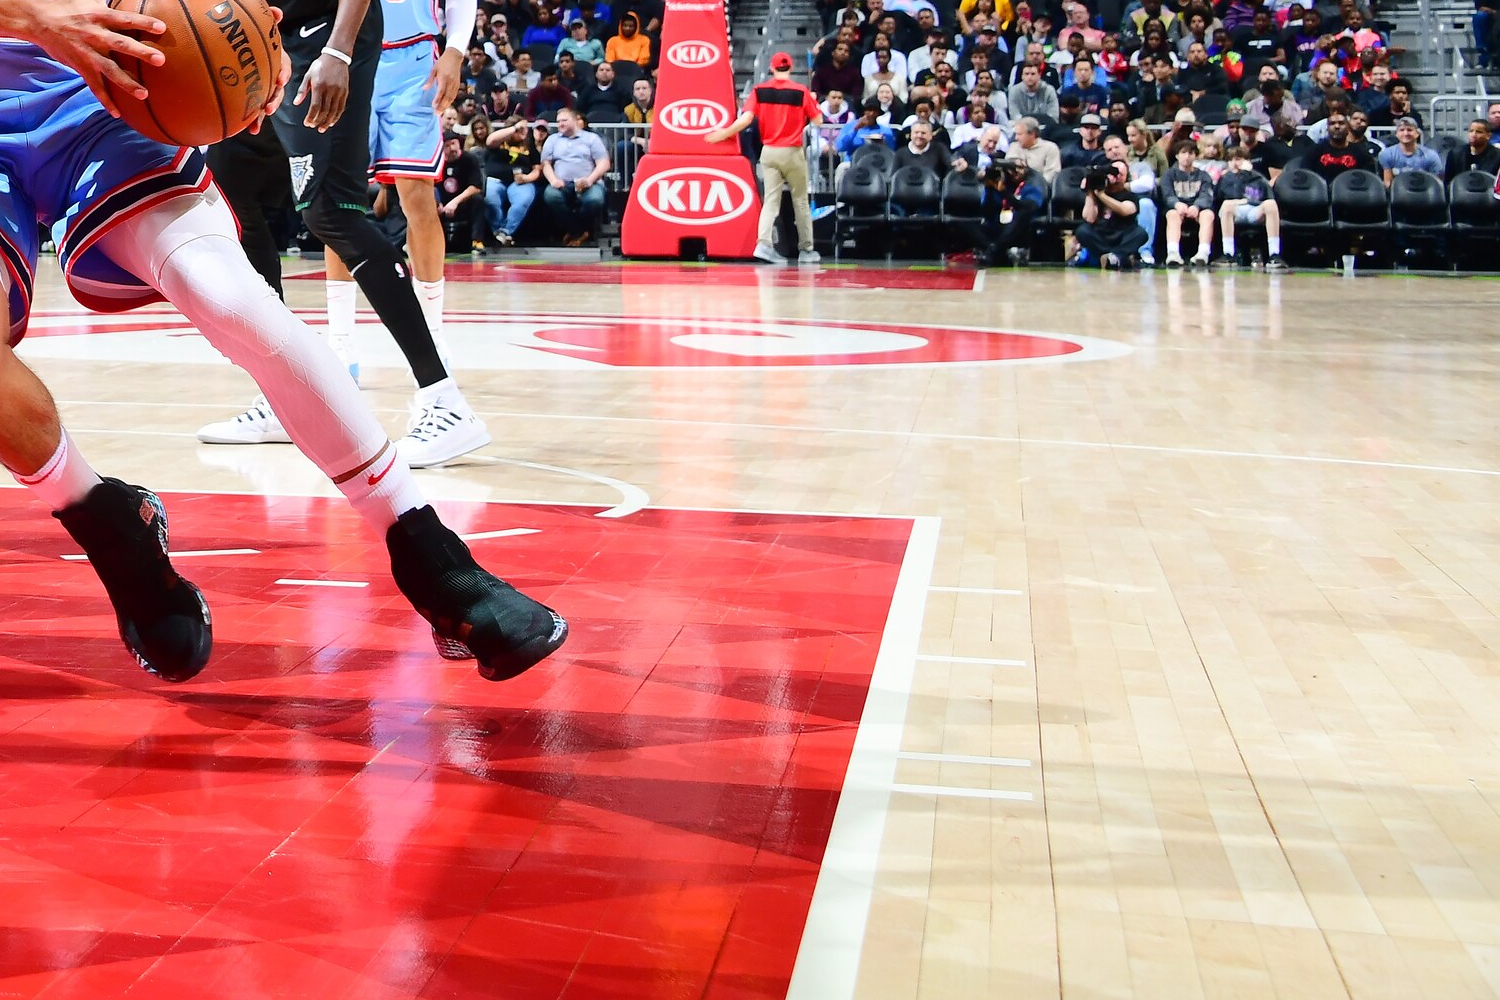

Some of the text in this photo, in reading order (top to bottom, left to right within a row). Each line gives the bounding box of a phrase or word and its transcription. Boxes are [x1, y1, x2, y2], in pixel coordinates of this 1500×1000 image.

[676, 45, 711, 63] KIA
[672, 106, 717, 127] KIA
[657, 180, 734, 212] KIA
